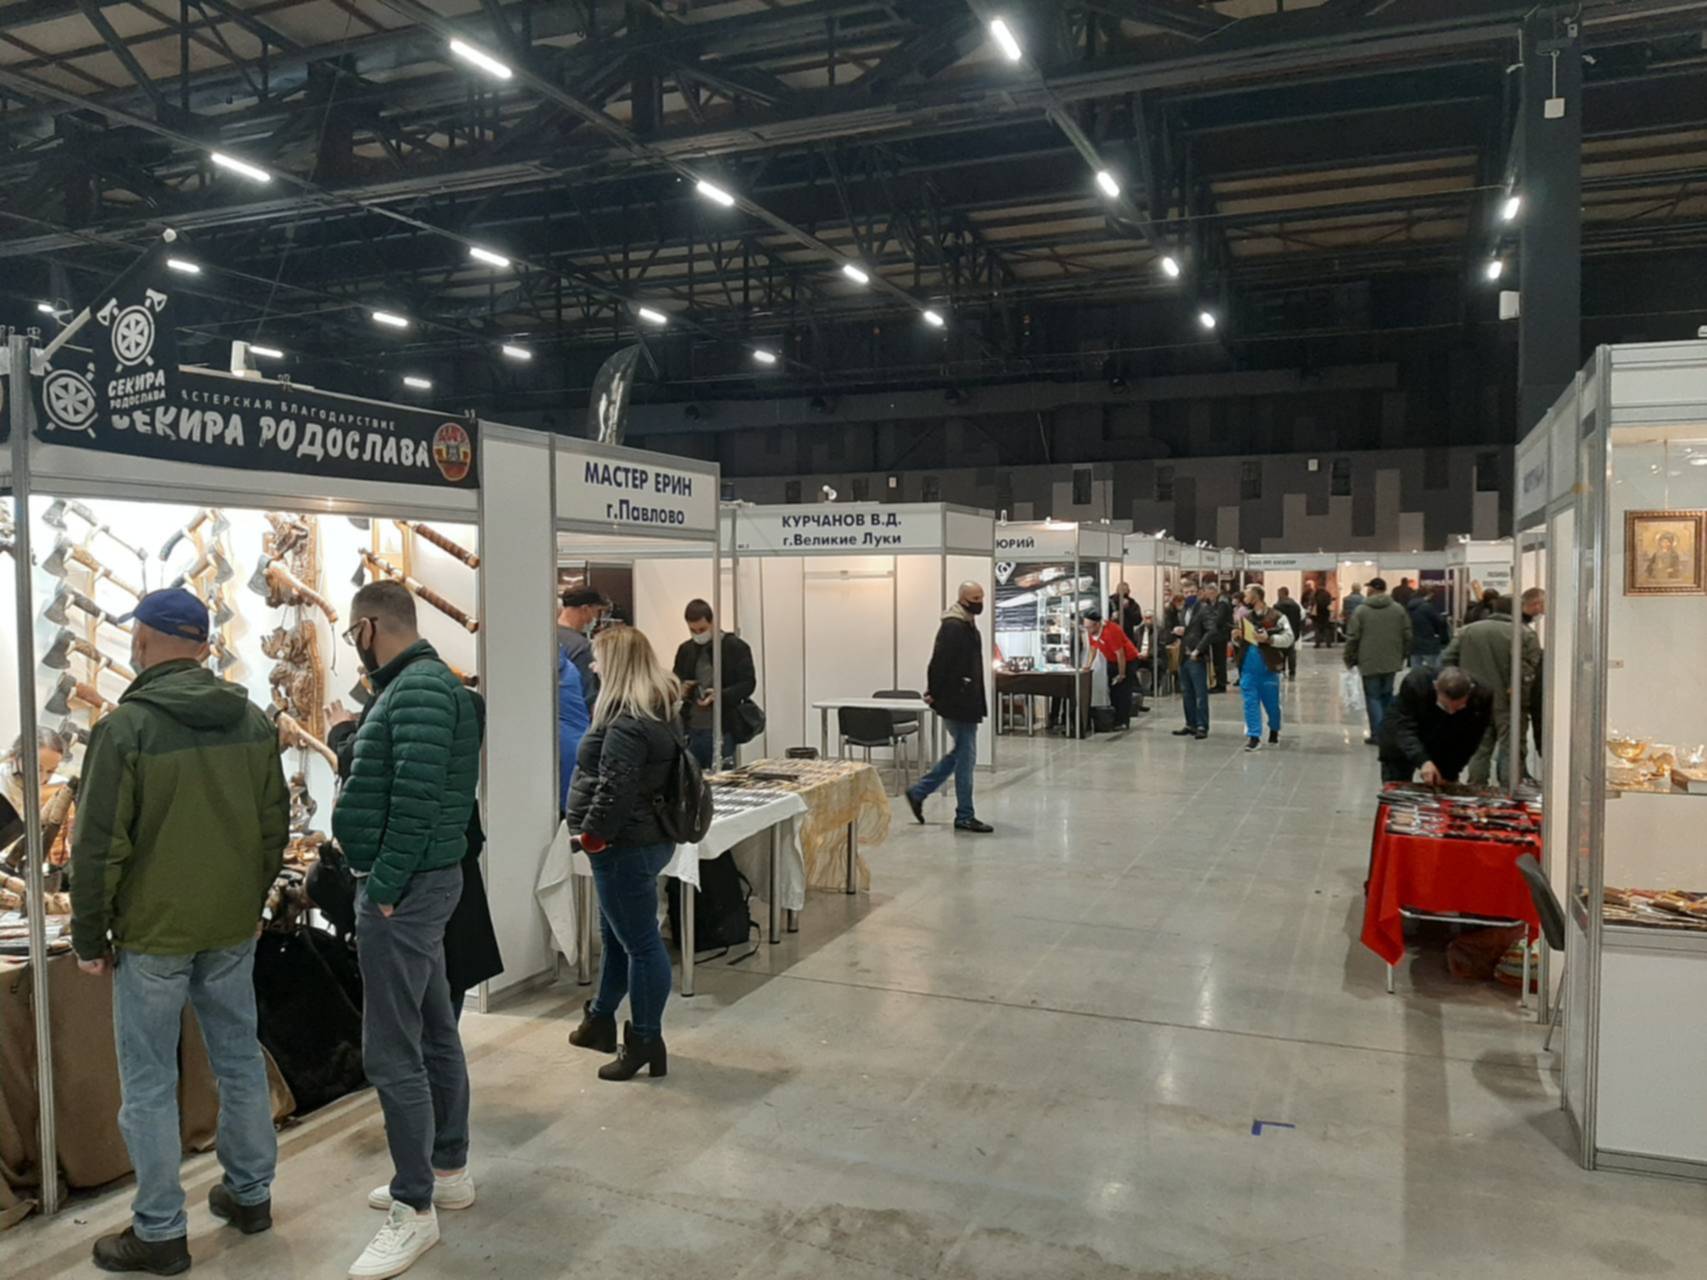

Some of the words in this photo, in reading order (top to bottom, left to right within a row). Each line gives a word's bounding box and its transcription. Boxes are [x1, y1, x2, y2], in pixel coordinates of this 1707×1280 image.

[107, 369, 166, 397] СЕКИРА
[259, 416, 430, 468] РОДОСЛАВА
[584, 461, 649, 490] МАСТЕР
[654, 472, 692, 497] ЕРИН
[606, 499, 685, 525] г.Павлово
[782, 513, 865, 528] КУРЧАНОВ
[870, 512, 903, 527] В.Д.
[783, 533, 858, 547] г.Великие
[862, 531, 902, 548] Луки
[996, 536, 1035, 549] ЮРИЙ
